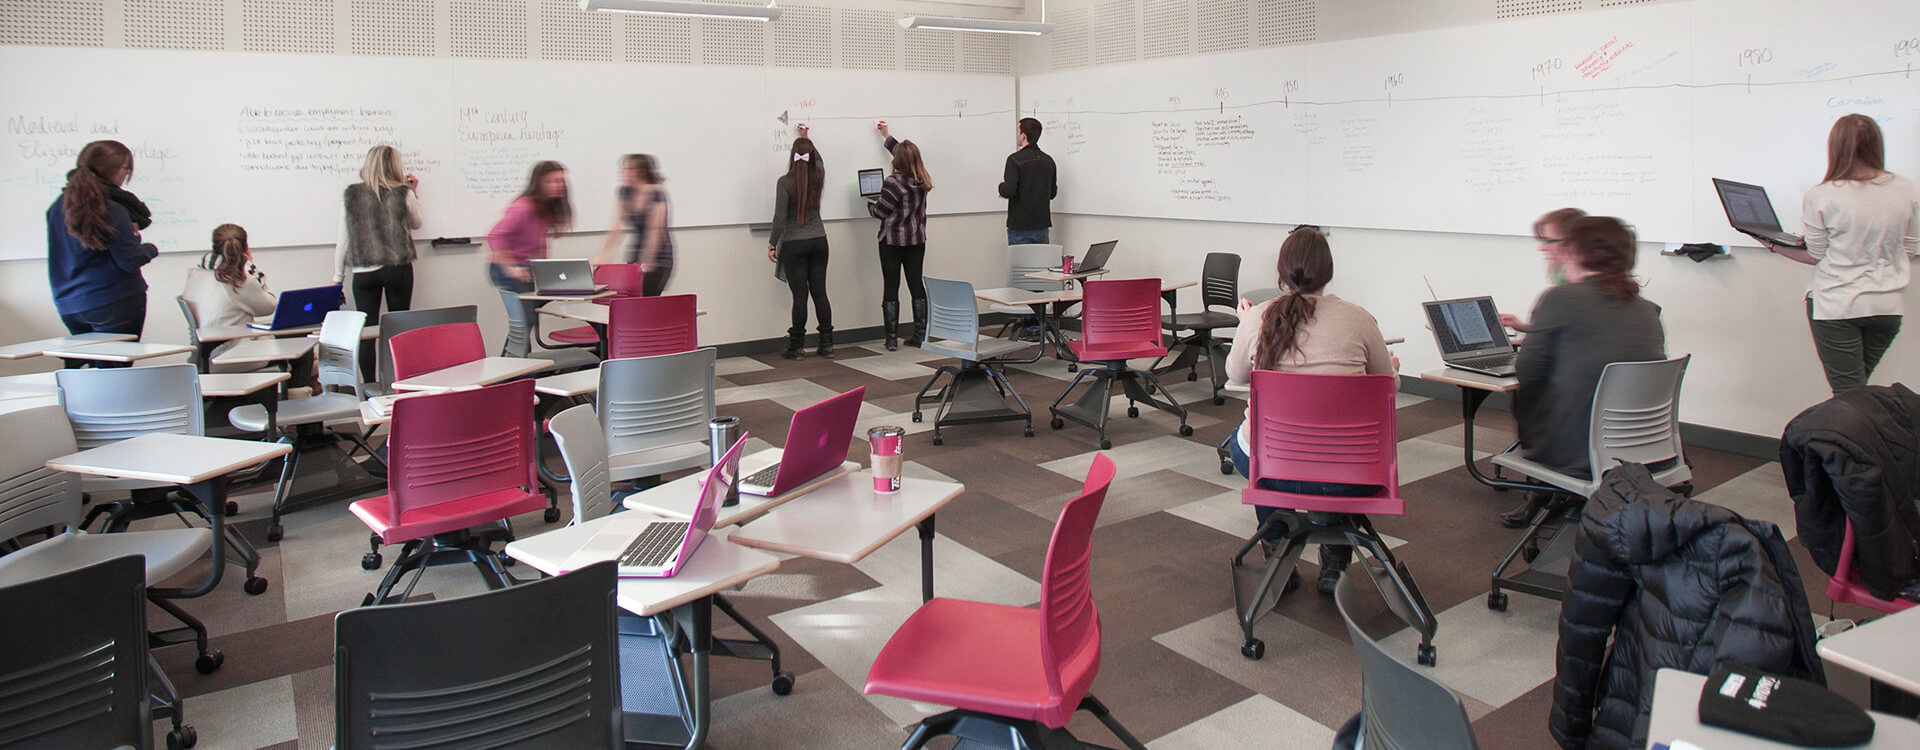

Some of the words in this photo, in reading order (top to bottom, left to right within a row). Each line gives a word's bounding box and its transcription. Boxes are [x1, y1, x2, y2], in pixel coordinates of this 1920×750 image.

[1532, 57, 1563, 81] 1970
[1738, 51, 1774, 76] 1980
[1384, 72, 1404, 90] 1960
[7, 113, 79, 136] Medieval
